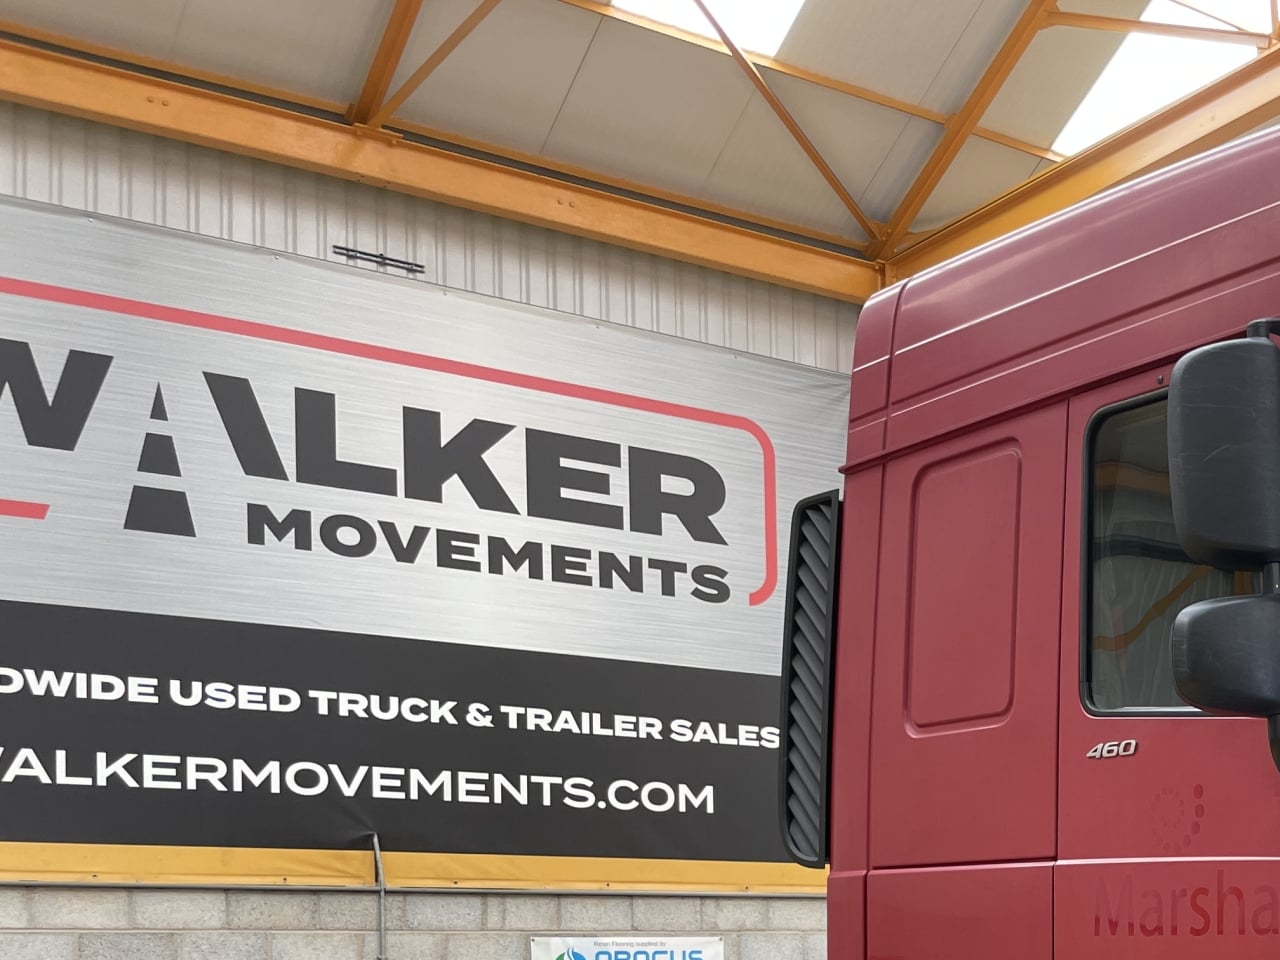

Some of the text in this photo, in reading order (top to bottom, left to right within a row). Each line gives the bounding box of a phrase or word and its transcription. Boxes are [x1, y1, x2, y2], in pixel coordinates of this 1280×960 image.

[246, 502, 731, 602] MOVEMENTS
[169, 679, 301, 713] USED
[308, 689, 459, 726] TRUCK
[465, 702, 494, 728] &
[500, 705, 663, 741] TRAILER
[669, 719, 780, 749] SALES
[0, 746, 714, 814] ALKERMOVEMENTS.COM
[1086, 739, 1137, 759] 460
